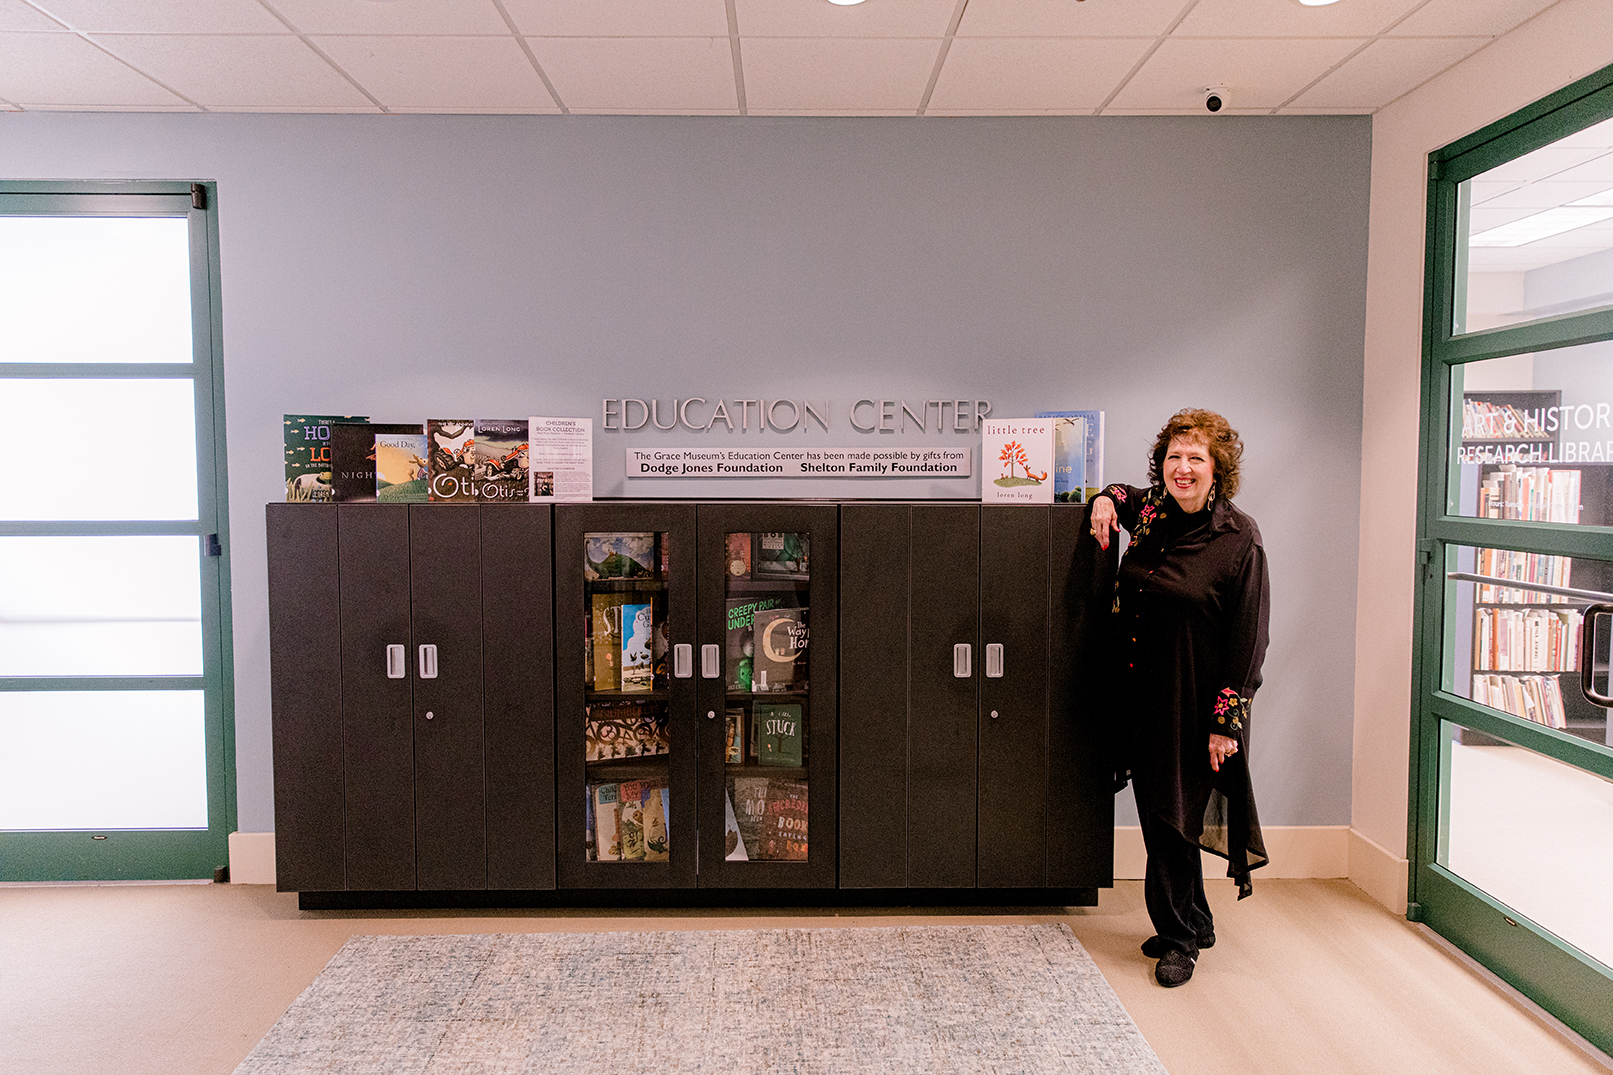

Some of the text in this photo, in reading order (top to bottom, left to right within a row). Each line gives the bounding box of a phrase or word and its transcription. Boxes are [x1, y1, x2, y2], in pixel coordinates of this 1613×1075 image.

[602, 397, 992, 431] EDUCATION CENTER
[1461, 412, 1499, 437] ART
[1524, 402, 1613, 432] HISTOR
[304, 425, 330, 440] HO
[478, 425, 521, 434] LOREN LONG
[988, 425, 1018, 435] little
[380, 440, 399, 448] Good
[401, 440, 416, 450] Day,
[634, 451, 964, 462] The Grace Museum's Education Center has been made possible by gifts from
[1457, 443, 1542, 465] RESEARCH
[640, 462, 958, 475] Dodge Jones Foundation Shelton Family Foundation
[482, 483, 515, 499] Otis
[1018, 492, 1033, 500] long
[728, 602, 758, 619] CREEPY
[788, 626, 807, 639] Way
[766, 719, 797, 737] STUCK
[778, 816, 808, 831] BOOK
